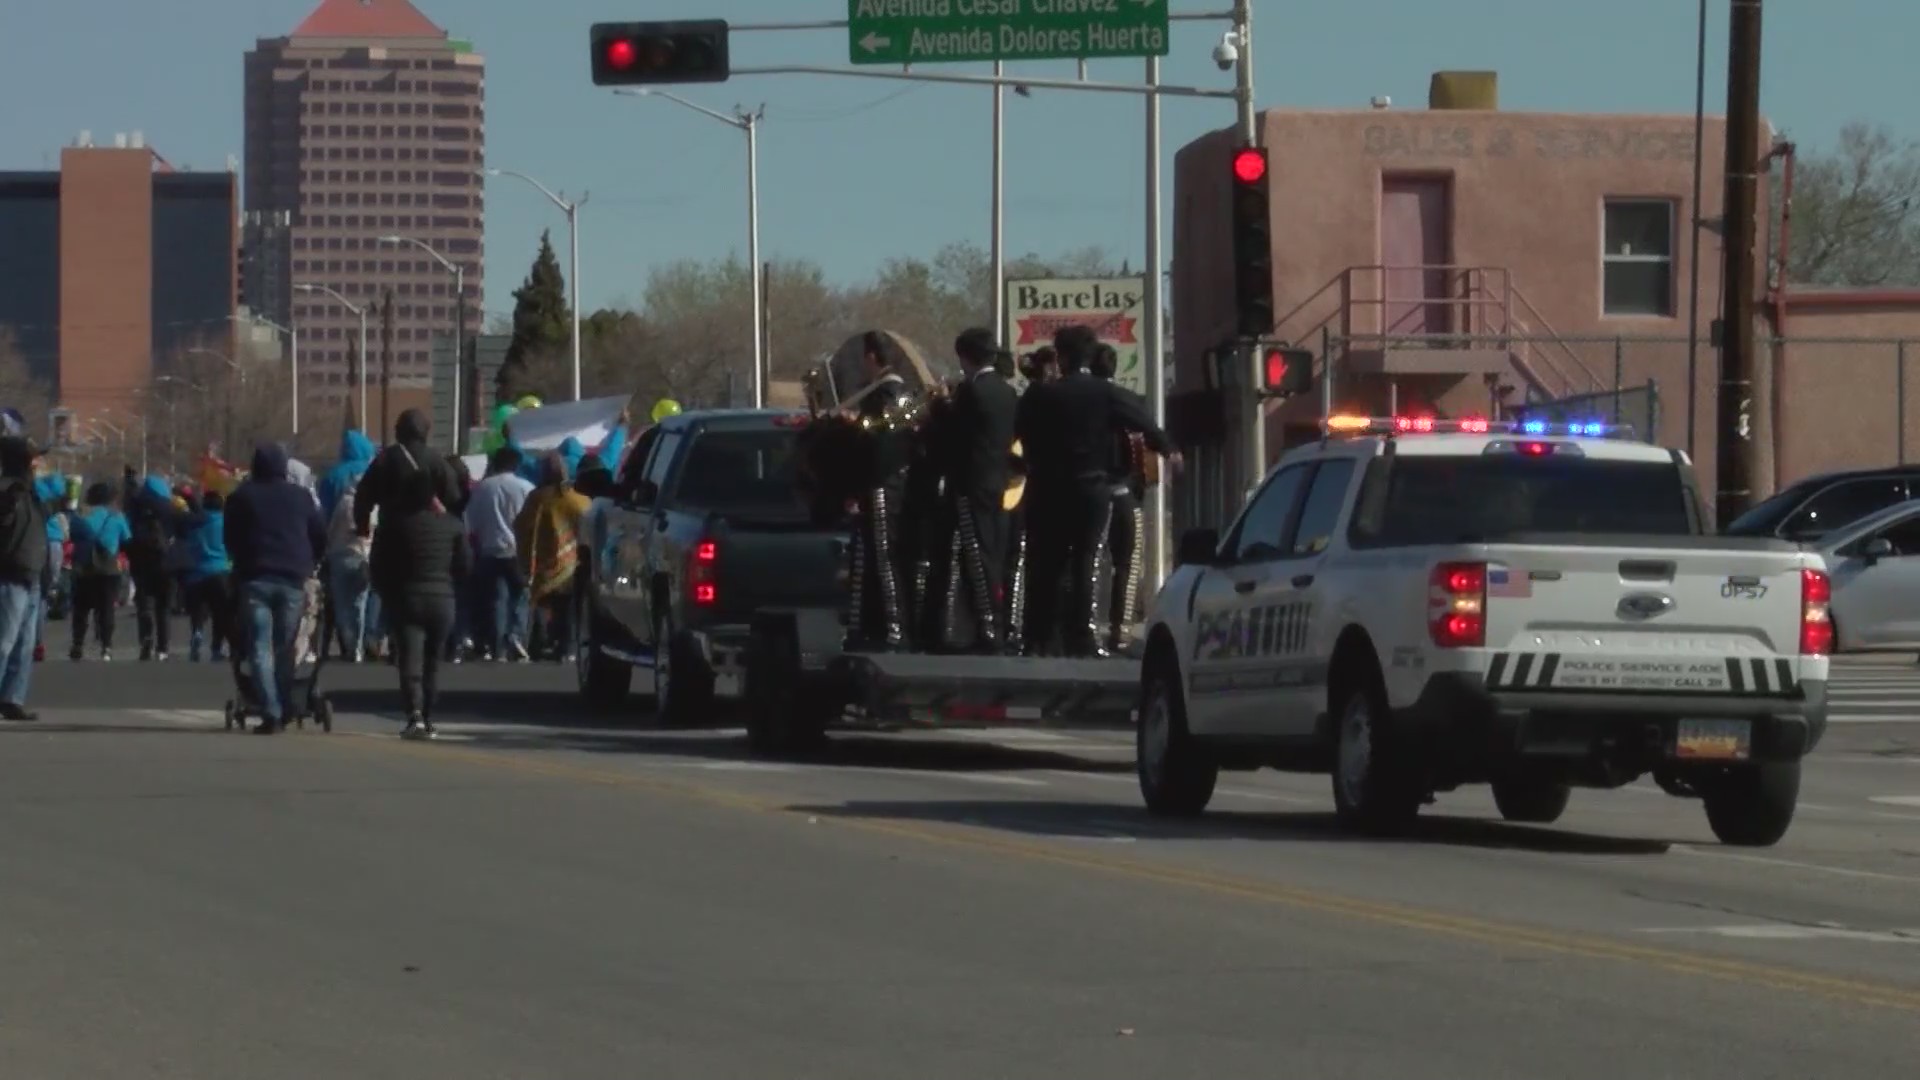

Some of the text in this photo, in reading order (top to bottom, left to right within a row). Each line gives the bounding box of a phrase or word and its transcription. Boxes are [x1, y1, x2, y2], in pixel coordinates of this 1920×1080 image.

[856, 0, 951, 18] Avenida
[909, 21, 1164, 56] Avenida Dolores Huerta
[1363, 124, 1474, 158] SALES
[1016, 284, 1138, 310] Barelas
[1563, 660, 1723, 674] POLICE SERVICE AIDE
